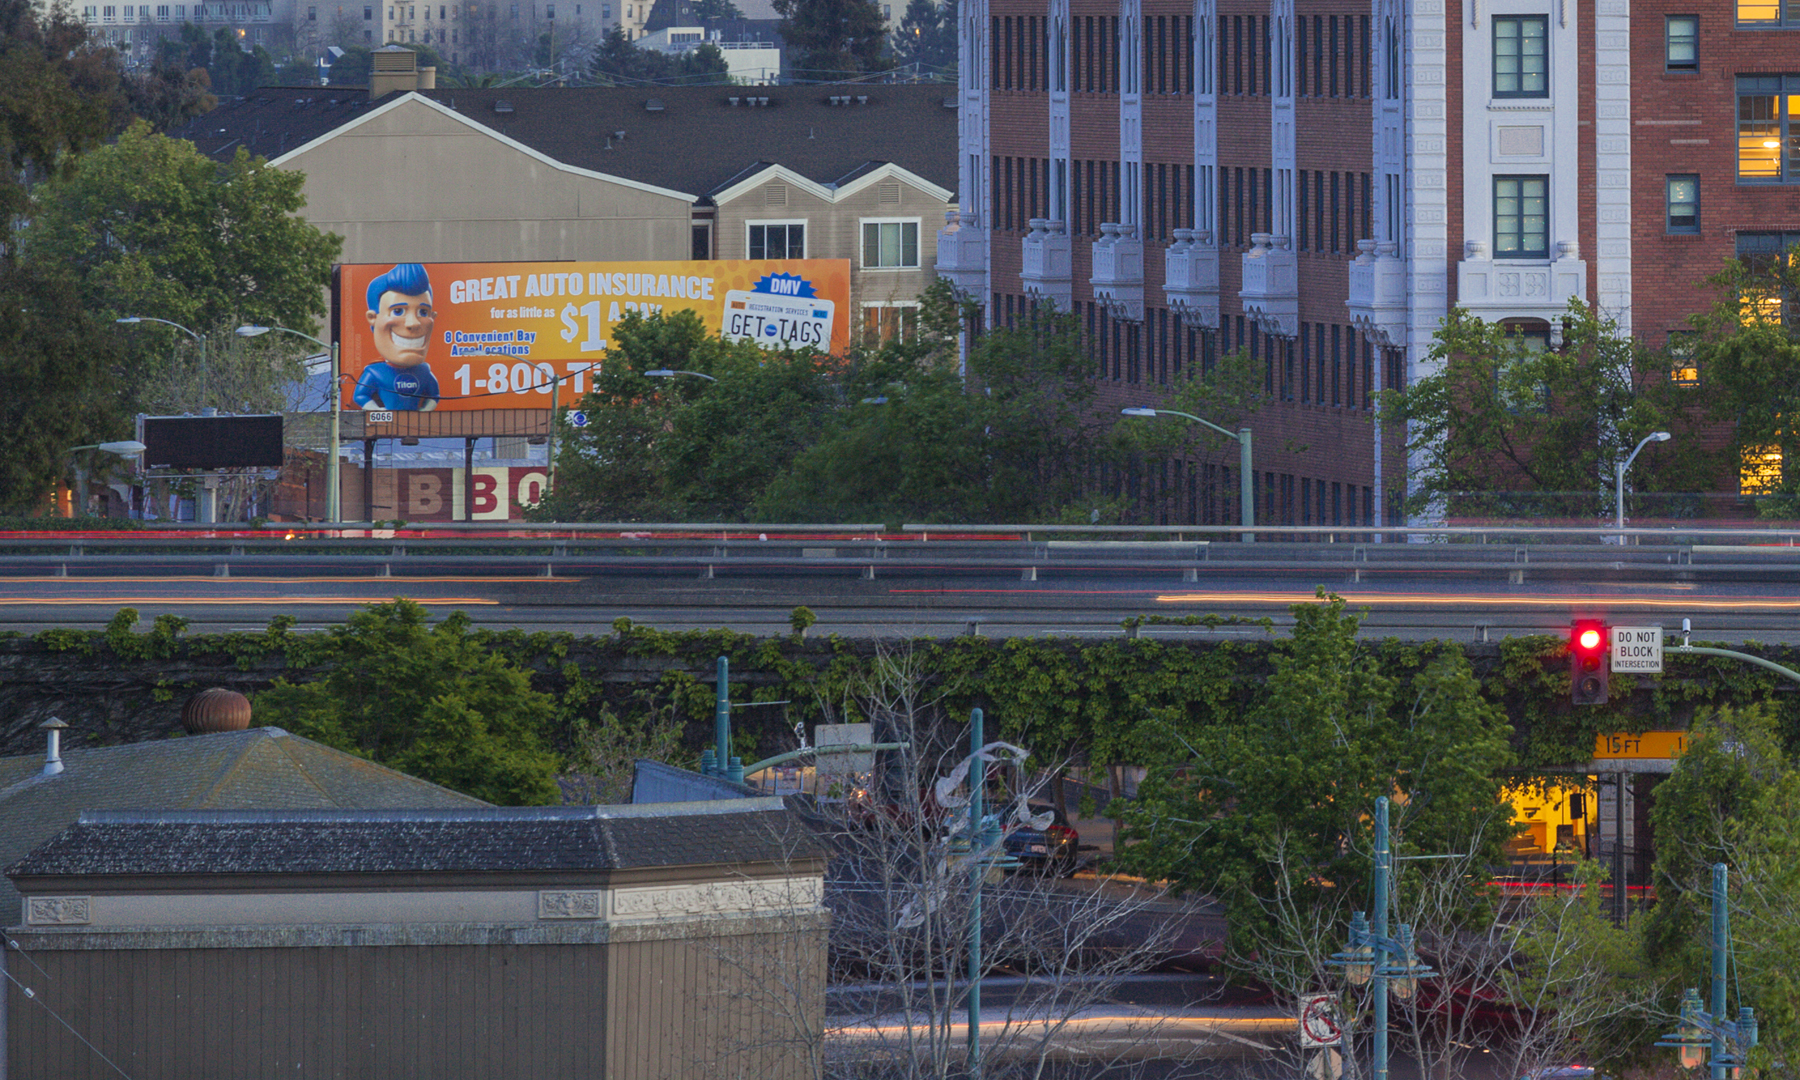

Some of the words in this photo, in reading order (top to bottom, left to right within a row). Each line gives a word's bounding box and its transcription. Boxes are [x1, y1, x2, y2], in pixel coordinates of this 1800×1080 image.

[450, 274, 521, 305] GREAT
[525, 273, 584, 298] AUTO
[588, 272, 714, 301] INSURANCE
[769, 277, 802, 296] DMV
[490, 306, 506, 319] for
[506, 308, 518, 318] as
[519, 306, 543, 318] little
[543, 308, 556, 318] as
[607, 301, 621, 322] A
[748, 303, 784, 313] REGISTRATION
[785, 307, 809, 316] SERVICES
[560, 300, 607, 352] $1
[731, 313, 766, 338] GET
[779, 318, 823, 344] TAGS
[444, 330, 453, 344] 8
[454, 329, 514, 344] Convenient
[516, 328, 537, 344] Bay
[396, 381, 418, 389] Titan
[370, 412, 392, 421] 6066
[1618, 631, 1632, 642] DO
[1636, 631, 1656, 643] NOT
[1620, 646, 1654, 658] BLOCK
[1614, 660, 1660, 669] INTERSECTION
[1606, 736, 1621, 754] 15
[1624, 740, 1641, 753] FT
